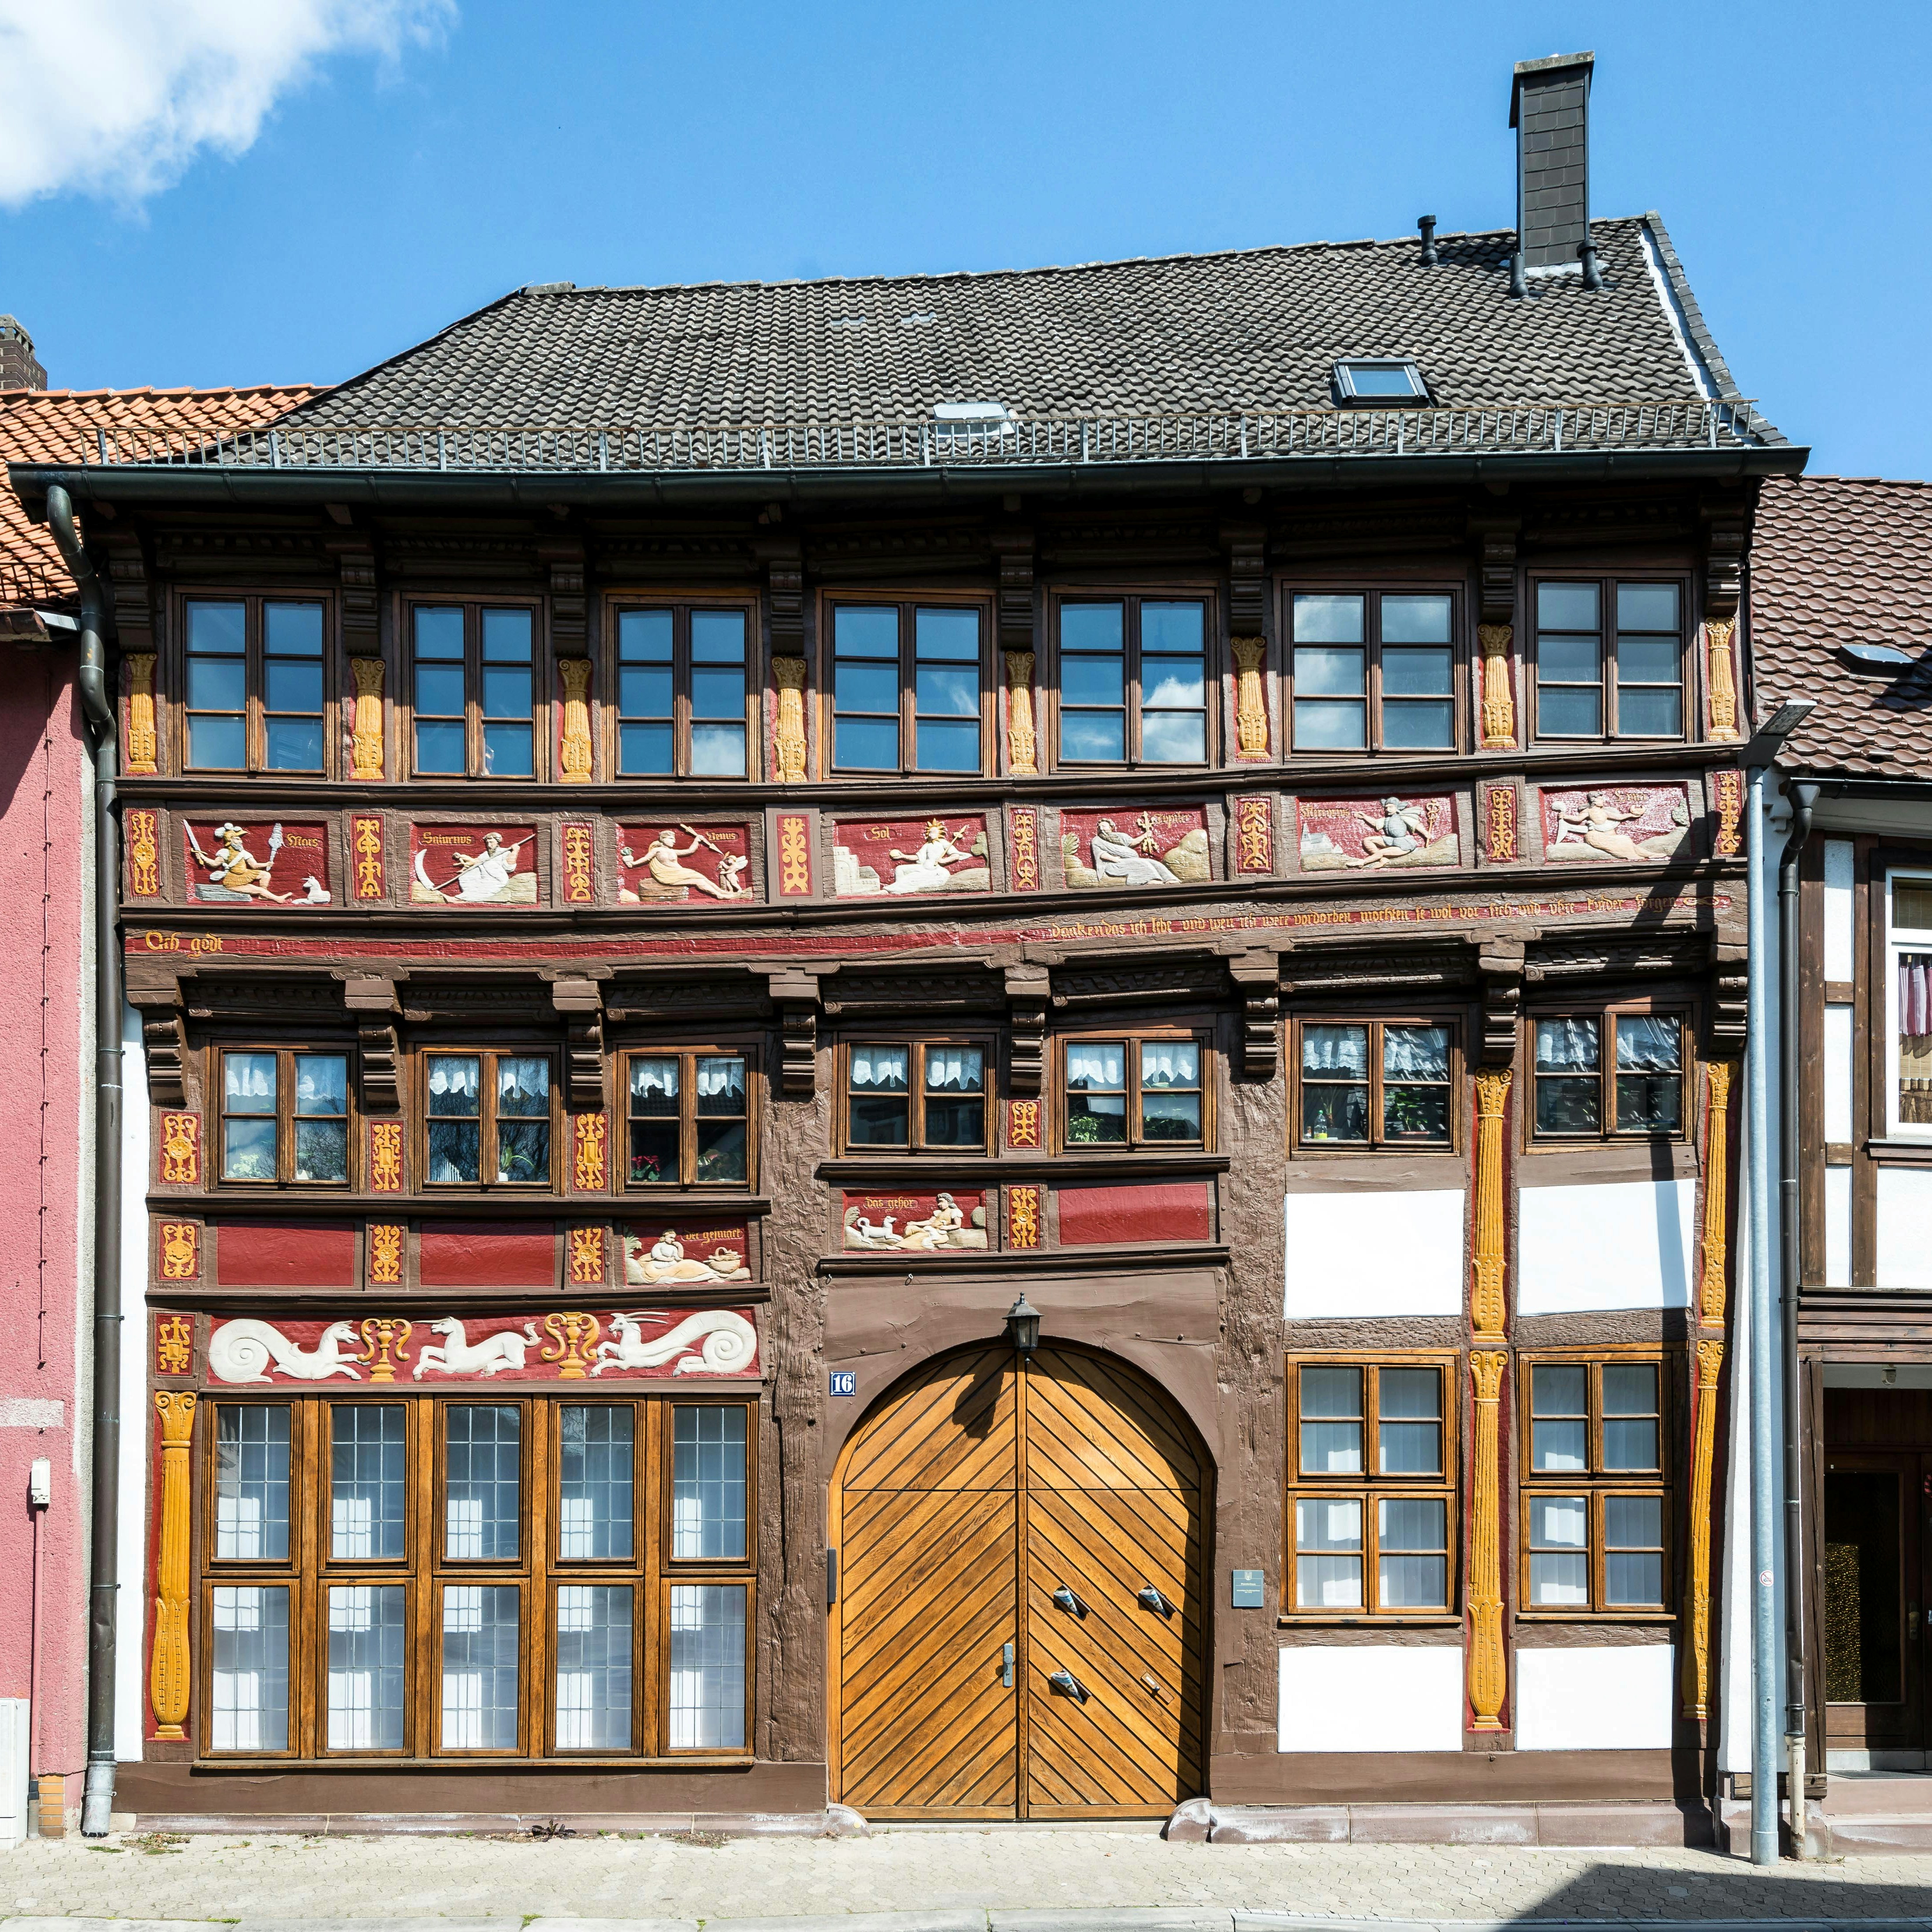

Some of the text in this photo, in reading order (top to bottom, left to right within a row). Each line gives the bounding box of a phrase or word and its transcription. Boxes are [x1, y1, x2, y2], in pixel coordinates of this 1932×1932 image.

[871, 826, 890, 839] Sol
[1128, 918, 1147, 934] ich
[1238, 912, 1257, 928] ich
[1430, 903, 1453, 919] wol
[1459, 906, 1479, 919] vor
[865, 1196, 884, 1208] das
[833, 1374, 853, 1392] 16
